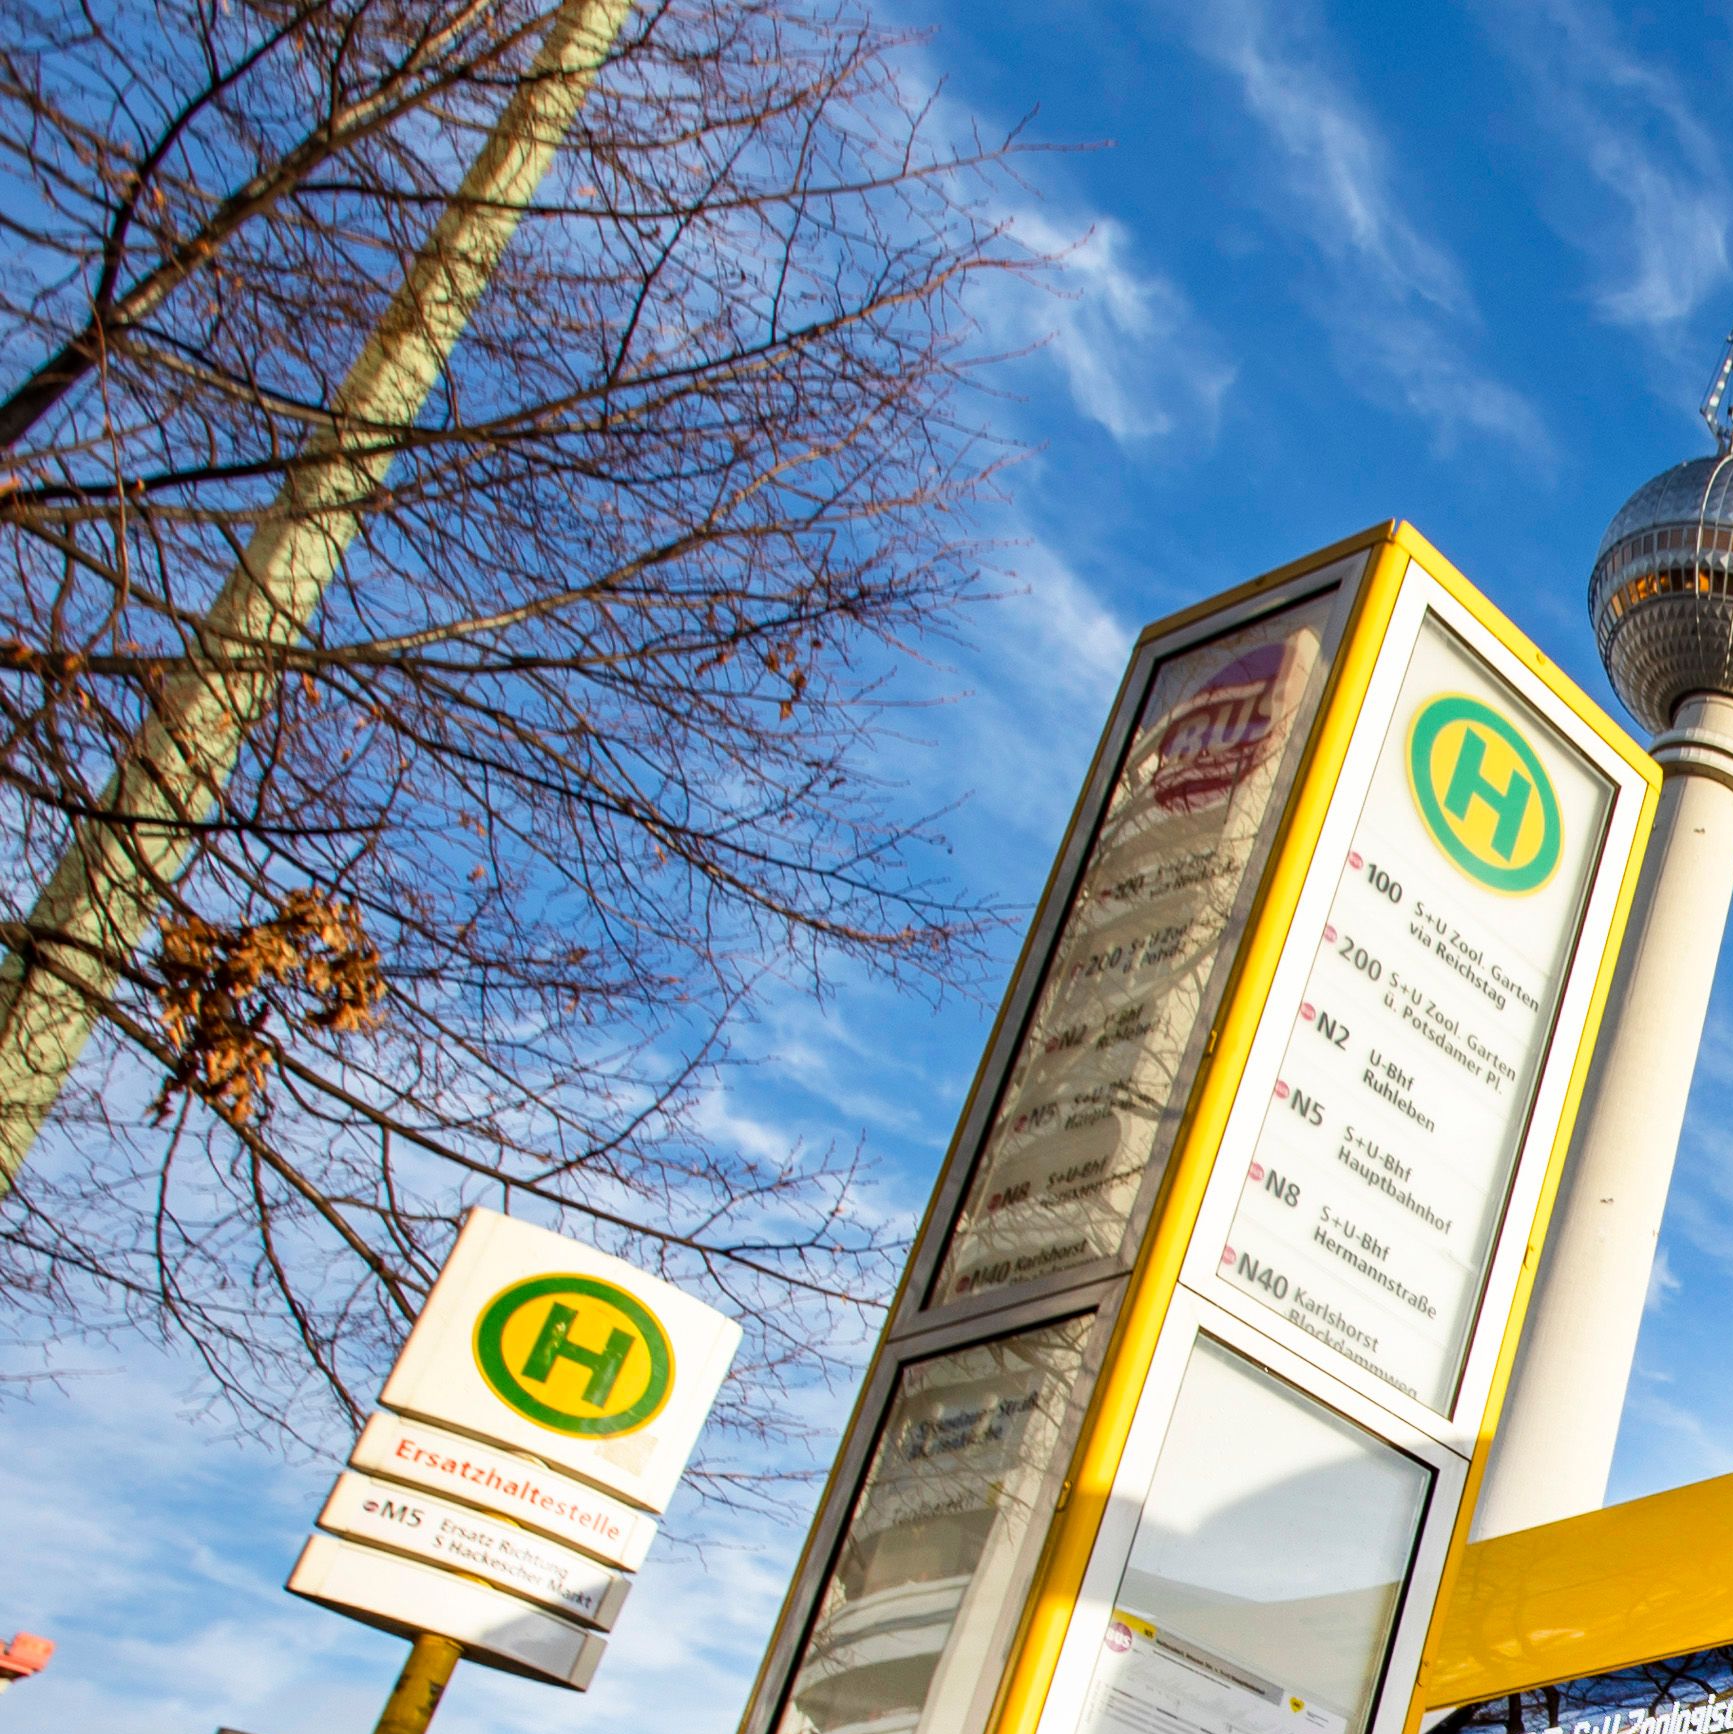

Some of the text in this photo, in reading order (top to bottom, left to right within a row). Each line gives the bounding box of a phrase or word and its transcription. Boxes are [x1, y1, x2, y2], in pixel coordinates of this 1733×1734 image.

[1442, 727, 1532, 862] H
[1367, 862, 1540, 1013] 100 S+U Zool. Garten
[1409, 922, 1507, 1011] via Reichstag
[1316, 1011, 1415, 1092] N2 U-Bhf
[1338, 936, 1516, 1082] 200 S+U Zool. Garten
[1383, 992, 1502, 1095] ü. Potsdamer Pl.
[1290, 1088, 1413, 1183] N5 S+U-Bhf
[1362, 1068, 1436, 1133] Ruhleben
[1264, 1169, 1391, 1263] N8 S+U-Bhf
[1338, 1145, 1453, 1236] Hauptbahnhof
[1237, 1252, 1380, 1353] N40 Karlshorst
[1313, 1225, 1437, 1321] Hermannstraße
[520, 1301, 636, 1409] H
[394, 1439, 621, 1543] Ersatzhaltestelle
[380, 1498, 569, 1581] M5 Ersatz Richtung
[448, 1536, 543, 1587] Hackescher
[546, 1577, 593, 1610] Markt
